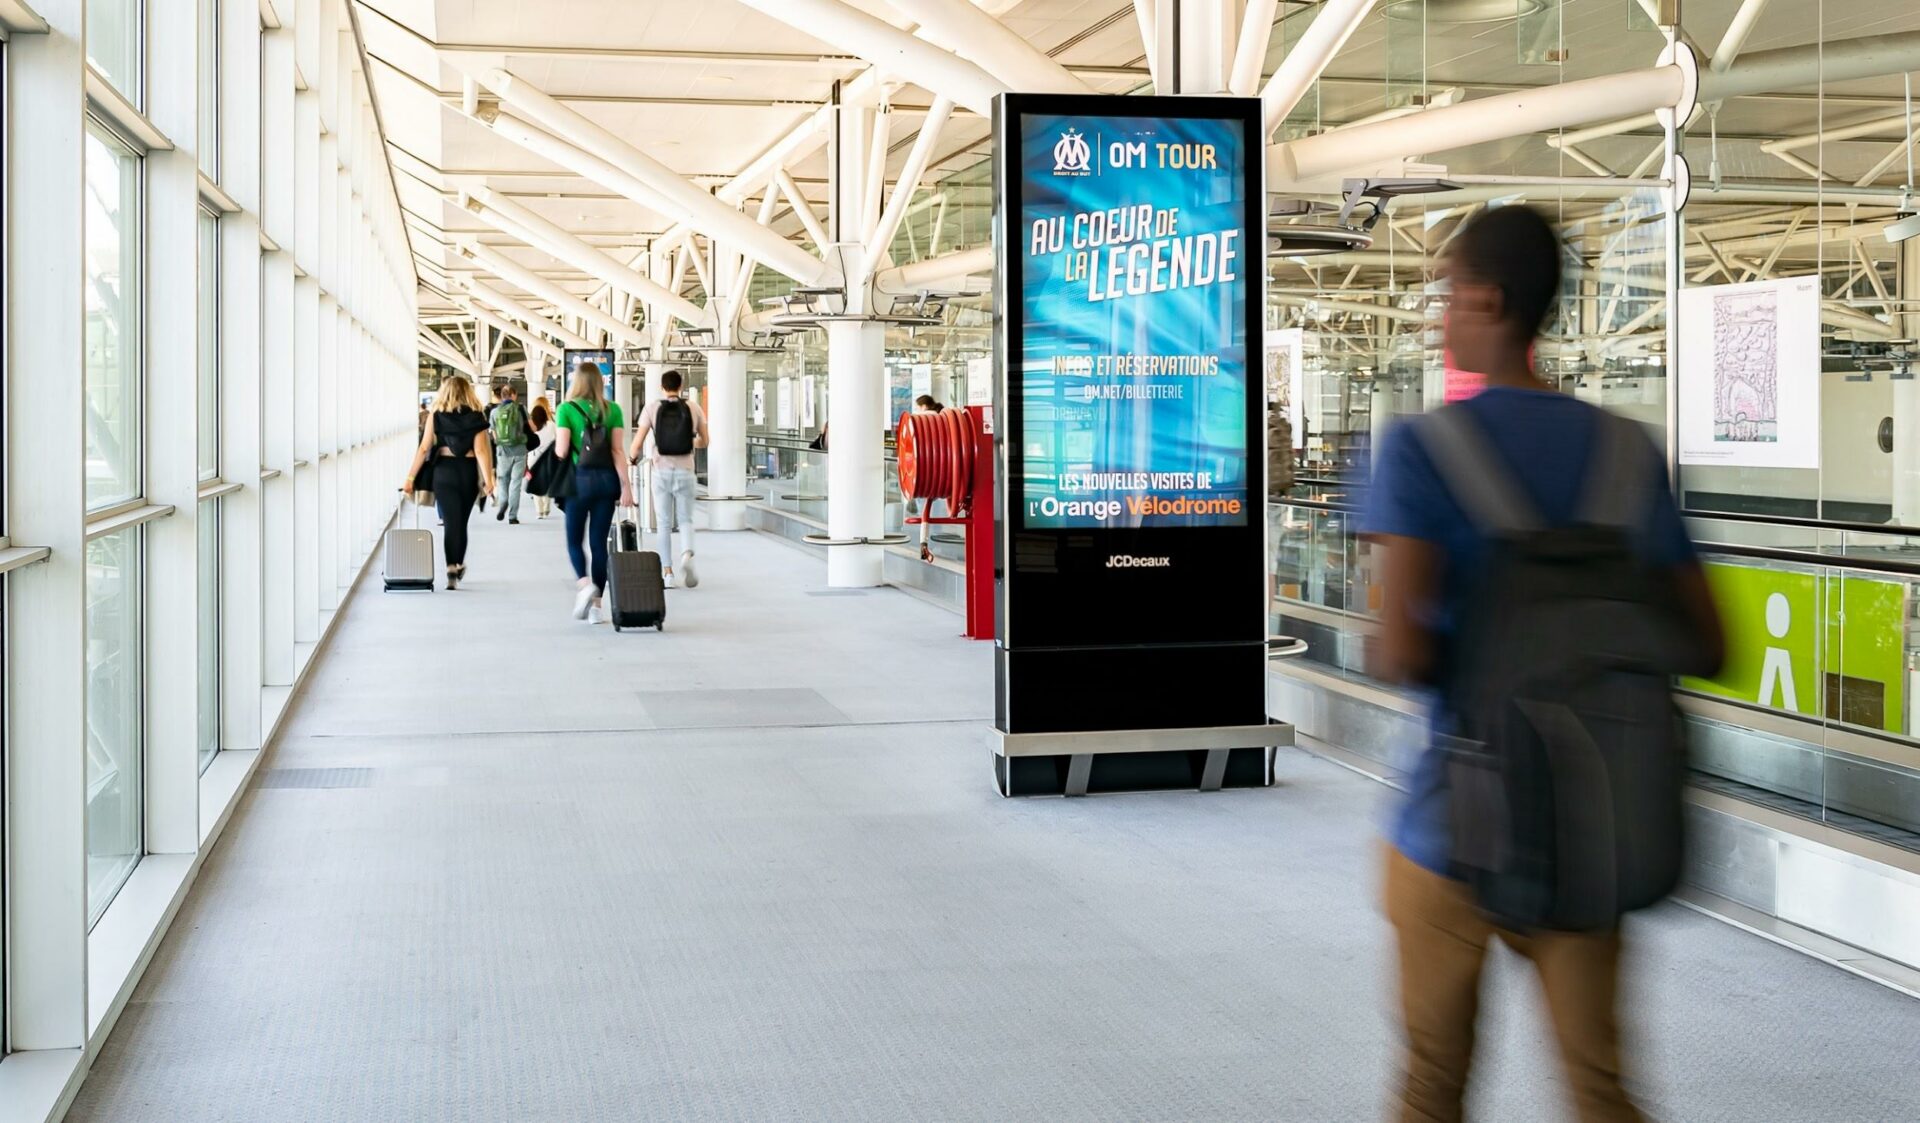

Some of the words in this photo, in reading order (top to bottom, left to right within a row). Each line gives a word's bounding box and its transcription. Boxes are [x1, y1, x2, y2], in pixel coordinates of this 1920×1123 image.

[1109, 142, 1146, 169] OM
[1156, 143, 1217, 170] TOUR
[1031, 216, 1066, 256] AU
[1072, 204, 1153, 250] COEUR
[1155, 207, 1179, 238] DE
[1065, 251, 1088, 282] LA
[1051, 355, 1092, 377] INFOS
[1097, 355, 1113, 376] ET
[1116, 352, 1219, 376] RÉSERVATIONS
[1084, 384, 1184, 400] OM.NET/BILLETTERIE
[1058, 473, 1080, 491] LES
[1082, 473, 1147, 491] NOUVELLES
[1150, 472, 1194, 490] VISITES
[1197, 472, 1212, 489] DE
[1126, 495, 1241, 515] Vélodrome
[1105, 555, 1170, 568] JCDecaux
